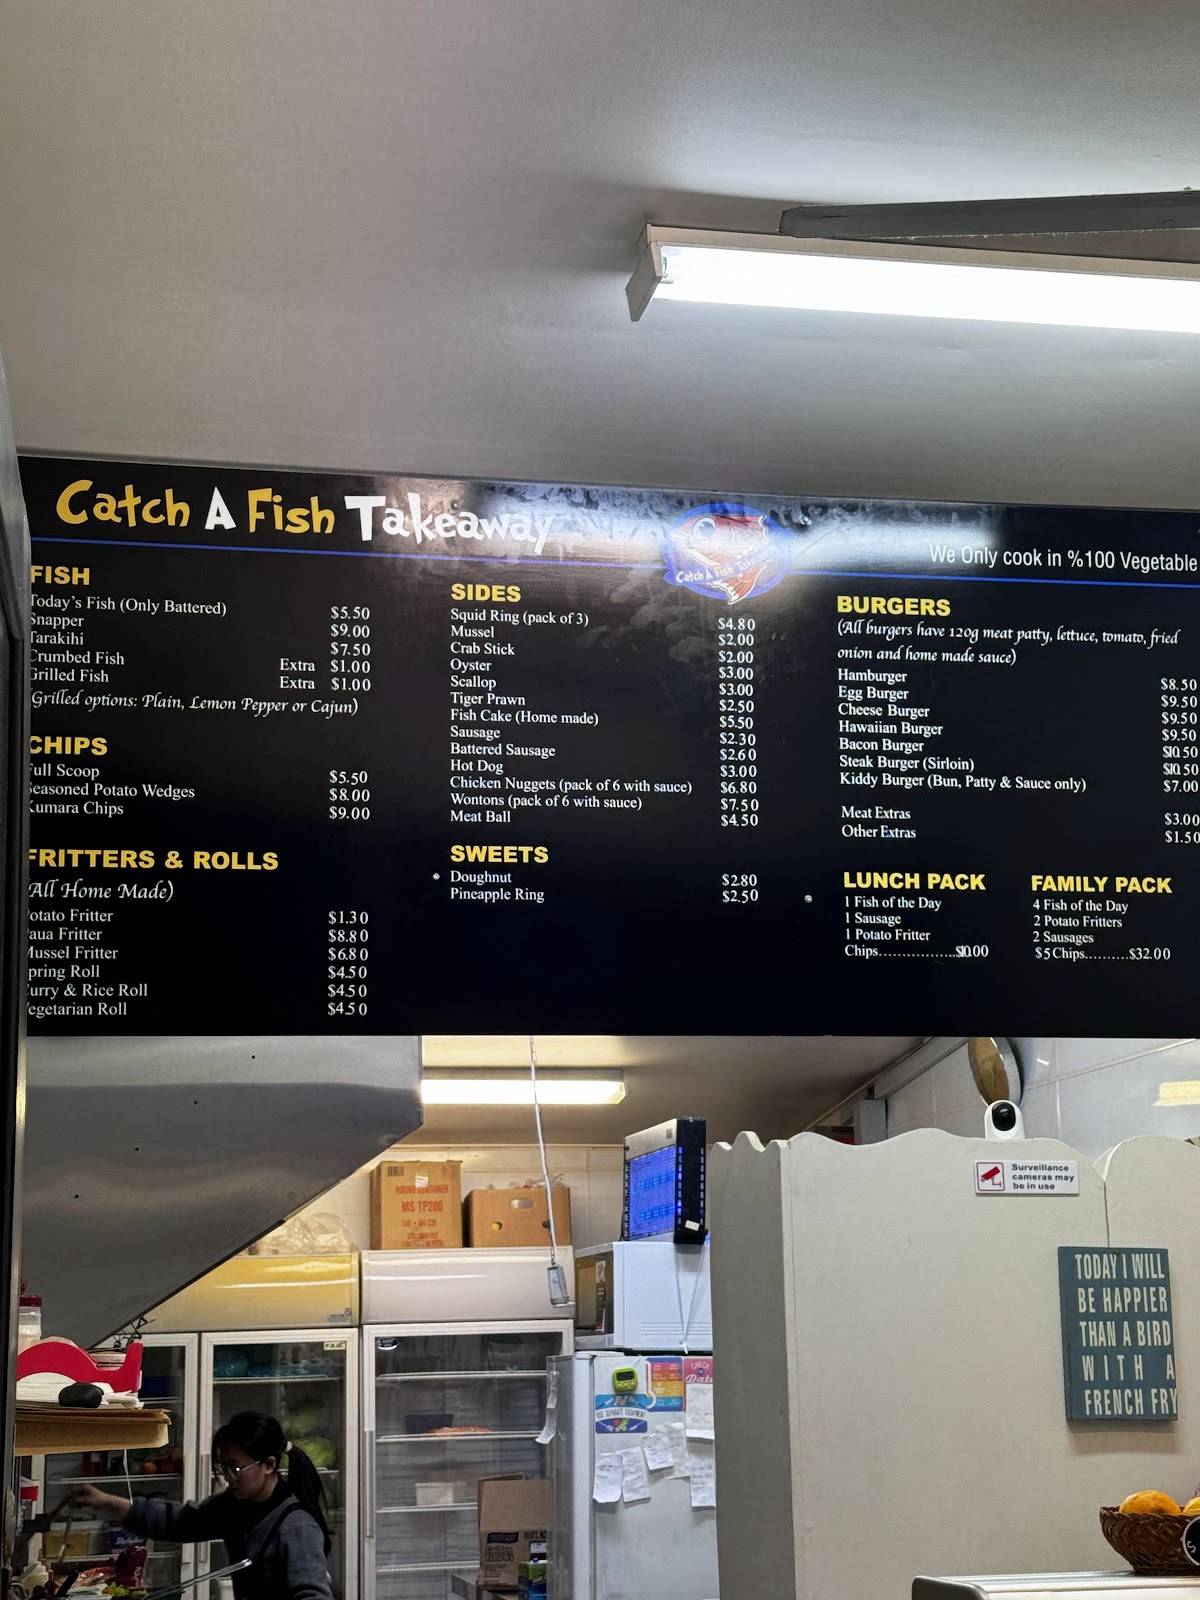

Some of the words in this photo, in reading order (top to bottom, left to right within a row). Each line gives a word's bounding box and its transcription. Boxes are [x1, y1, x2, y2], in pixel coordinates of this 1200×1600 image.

[56, 479, 191, 528] Catch
[204, 486, 237, 531] A
[247, 487, 336, 535] Fish
[344, 492, 553, 556] Takeaway
[929, 543, 956, 564] We
[961, 545, 998, 568] Only
[1003, 548, 1042, 567] cook
[1047, 548, 1061, 567] in
[1067, 549, 1115, 569] %100
[1119, 551, 1198, 574] Vegetable
[451, 583, 521, 602] SIDES
[87, 596, 115, 610] Fish
[120, 598, 159, 614] (Only
[164, 599, 226, 617] Battered)
[331, 606, 370, 620] $5.50
[837, 595, 950, 616] BURGERS
[450, 608, 486, 623] Squid
[490, 609, 519, 625] Ring
[522, 611, 556, 626] (pack
[559, 612, 574, 624] of
[576, 612, 588, 626] 3)
[330, 623, 369, 638] $9.00
[451, 625, 494, 637] Mussel
[837, 618, 864, 636] (All
[865, 619, 912, 640] burgers
[916, 620, 946, 636] have
[949, 626, 979, 643] 120g
[983, 627, 1013, 641] meat
[1017, 627, 1053, 647] patty,
[1056, 625, 1099, 645] lettuce,
[1102, 631, 1147, 646] tomato,
[1149, 628, 1181, 649] fried
[330, 642, 370, 656] $7.50
[450, 641, 480, 654] Crab
[484, 642, 515, 655] Stick
[95, 651, 124, 665] Fish
[837, 649, 872, 659] onion
[876, 647, 901, 660] and
[905, 647, 937, 661] home
[941, 647, 974, 662] made
[978, 648, 1016, 665] sauce)
[280, 658, 315, 671] Extra
[330, 659, 370, 673] $1.00
[450, 658, 491, 673] Oyster
[80, 669, 108, 682] Fish
[280, 676, 315, 689] Extra
[450, 675, 496, 691] Scallop
[838, 668, 907, 685] Hamburger
[331, 677, 370, 691] $1.00
[1160, 677, 1197, 690] $8.50
[450, 691, 483, 707] Tiger
[487, 692, 525, 705] Prawn
[838, 685, 863, 701] Egg
[866, 686, 909, 702] Burger
[1161, 694, 1197, 708] $9.50
[450, 708, 476, 720] Fish
[480, 709, 512, 721] Cake
[515, 710, 557, 724] (Home
[561, 712, 598, 726] made)
[838, 702, 882, 716] Cheese
[887, 703, 929, 719] Burger
[1161, 711, 1197, 724] $9.50
[450, 725, 500, 741] Sausage
[839, 720, 897, 733] Hawaiian
[901, 721, 943, 737] Burger
[1161, 728, 1196, 741] $9.50
[839, 737, 878, 750] Bacon
[882, 738, 924, 754] Burger
[450, 759, 473, 771] Hot
[477, 759, 503, 775] Dog
[839, 755, 873, 767] Steak
[877, 755, 919, 771] Burger
[922, 756, 974, 772] (Sirloin)
[450, 775, 501, 788] Chicken
[505, 776, 555, 792] Nuggets
[559, 778, 592, 793] (pack
[596, 778, 611, 790] of
[612, 779, 620, 791] 6
[623, 779, 650, 791] with
[653, 781, 692, 794] sauce)
[1163, 779, 1198, 792] $7.00
[450, 810, 481, 822] Meat
[486, 810, 510, 822] Ball
[841, 805, 872, 818] Meat
[875, 806, 910, 819] Extras
[1164, 812, 1200, 826] $3.00
[1165, 830, 1200, 843] $1.50
[450, 844, 548, 863] SWEETS
[450, 870, 511, 885] Doughnut
[721, 873, 757, 886] $2.80
[843, 871, 920, 889] LUNCH
[927, 873, 985, 890] PACK
[1031, 875, 1108, 892] FAMILY
[1115, 876, 1172, 893] PACK
[450, 887, 511, 903] Pineapple
[515, 888, 544, 903] Ring
[722, 889, 758, 903] $2.50
[854, 895, 878, 907] Fish
[881, 895, 895, 907] of
[897, 896, 915, 908] the
[918, 896, 941, 911] Day
[1033, 898, 1040, 910] 4
[1044, 898, 1067, 910] Fish
[1070, 899, 1083, 911] of
[1085, 899, 1102, 911] the
[1106, 900, 1128, 914] Day
[1033, 915, 1040, 926] 2
[1044, 915, 1079, 926] Potato
[1082, 915, 1122, 927] Fritters
[855, 928, 891, 940] Potato
[895, 929, 930, 940] Fritter
[1032, 930, 1039, 942] 2
[1043, 930, 1094, 945] Sausages
[1011, 1163, 1069, 1172] Surveillance
[1054, 1174, 1075, 1182] may
[1012, 1182, 1025, 1190] be
[1027, 1182, 1036, 1190] in
[401, 1201, 415, 1212] MS
[1075, 1253, 1118, 1280] TODAY
[1122, 1254, 1127, 1279] I
[1131, 1253, 1165, 1279] WILL
[1078, 1287, 1096, 1313] BE
[1103, 1286, 1168, 1313] HAPPIER
[1079, 1320, 1116, 1347] THAN
[1122, 1320, 1132, 1347] A
[1137, 1320, 1171, 1347] BIRD
[1081, 1354, 1144, 1381] WITH
[1166, 1353, 1175, 1380] A
[1084, 1388, 1144, 1416] FRENCH
[1151, 1388, 1177, 1416] FRY
